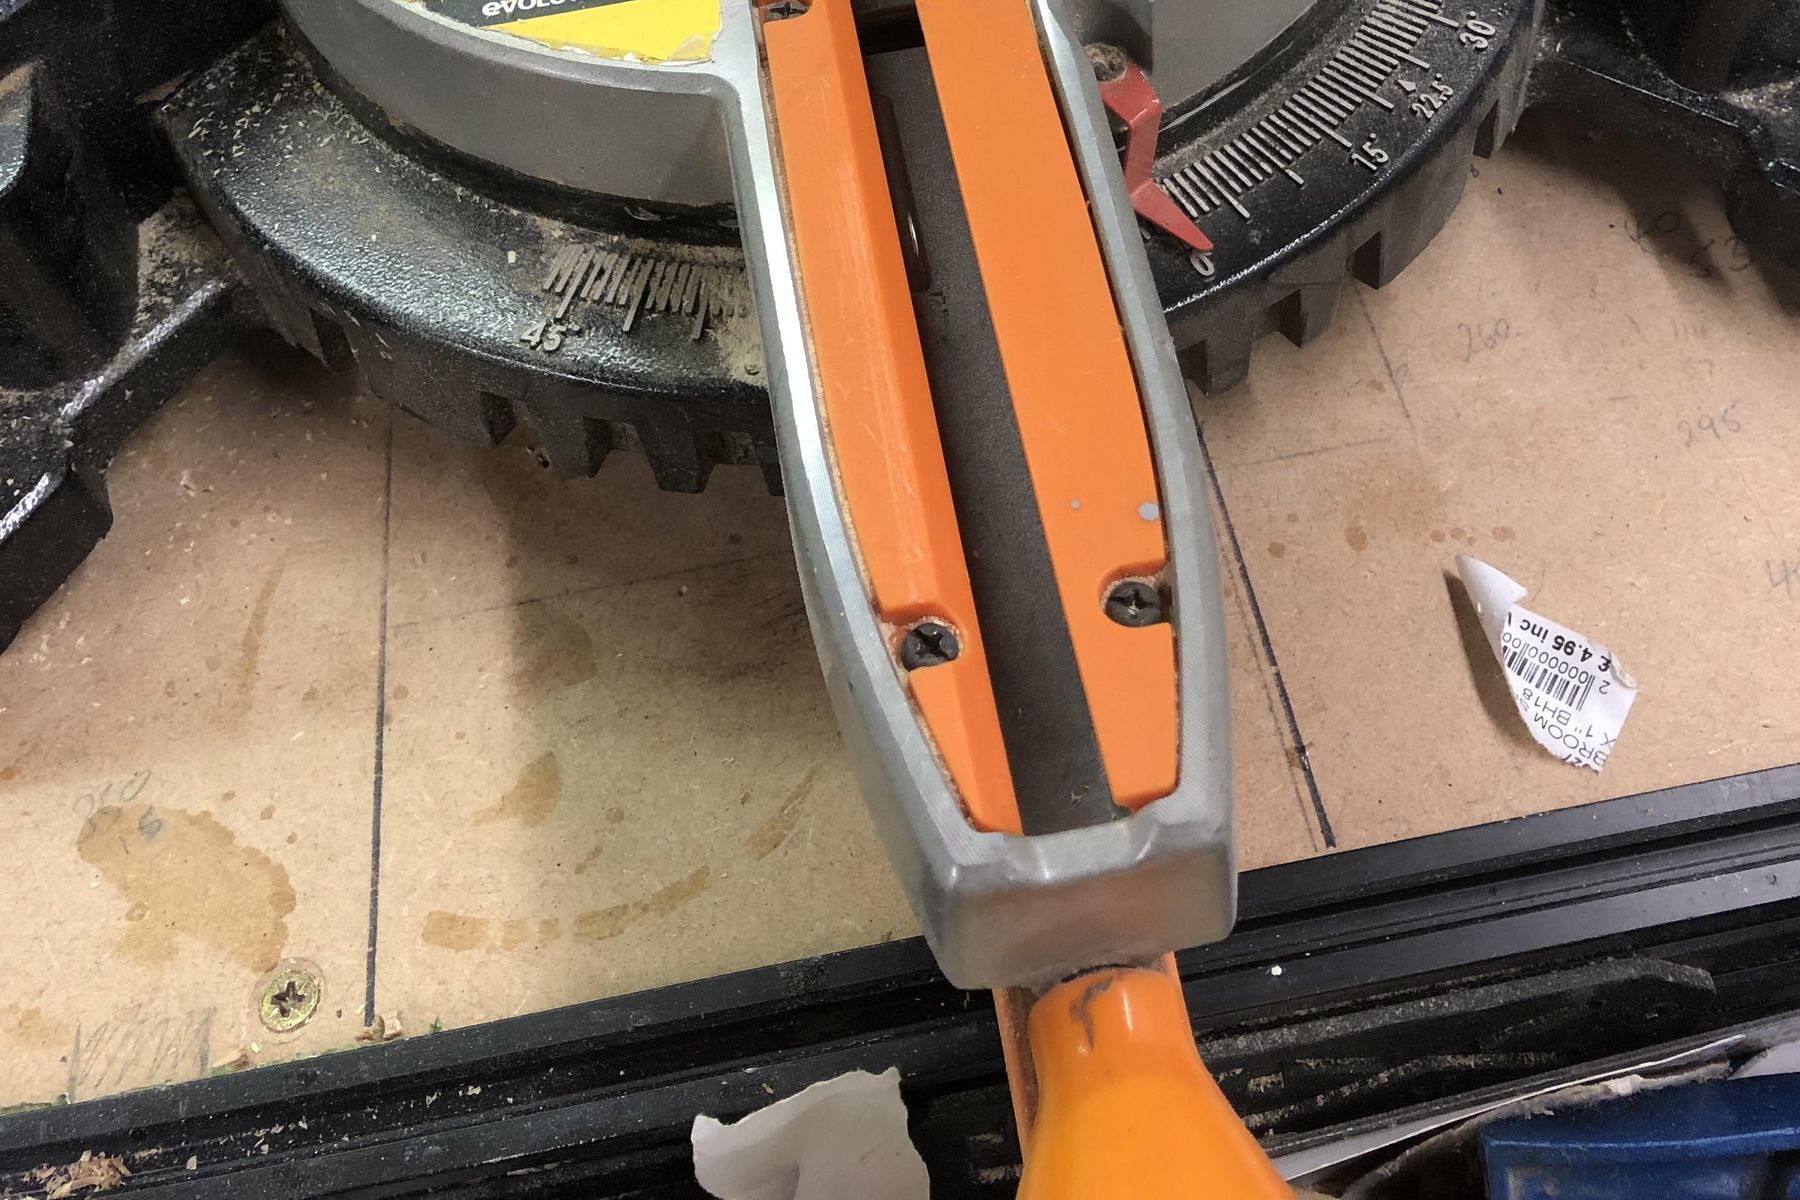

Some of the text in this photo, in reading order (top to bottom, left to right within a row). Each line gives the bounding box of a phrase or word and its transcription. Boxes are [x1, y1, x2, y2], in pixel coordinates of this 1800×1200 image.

[1519, 618, 1549, 644] inc
[1552, 635, 1593, 663] 4.95
[1598, 654, 1612, 672] £
[1598, 679, 1611, 695] 2
[1522, 687, 1572, 727] BH18
[1533, 711, 1607, 767] BROOM
